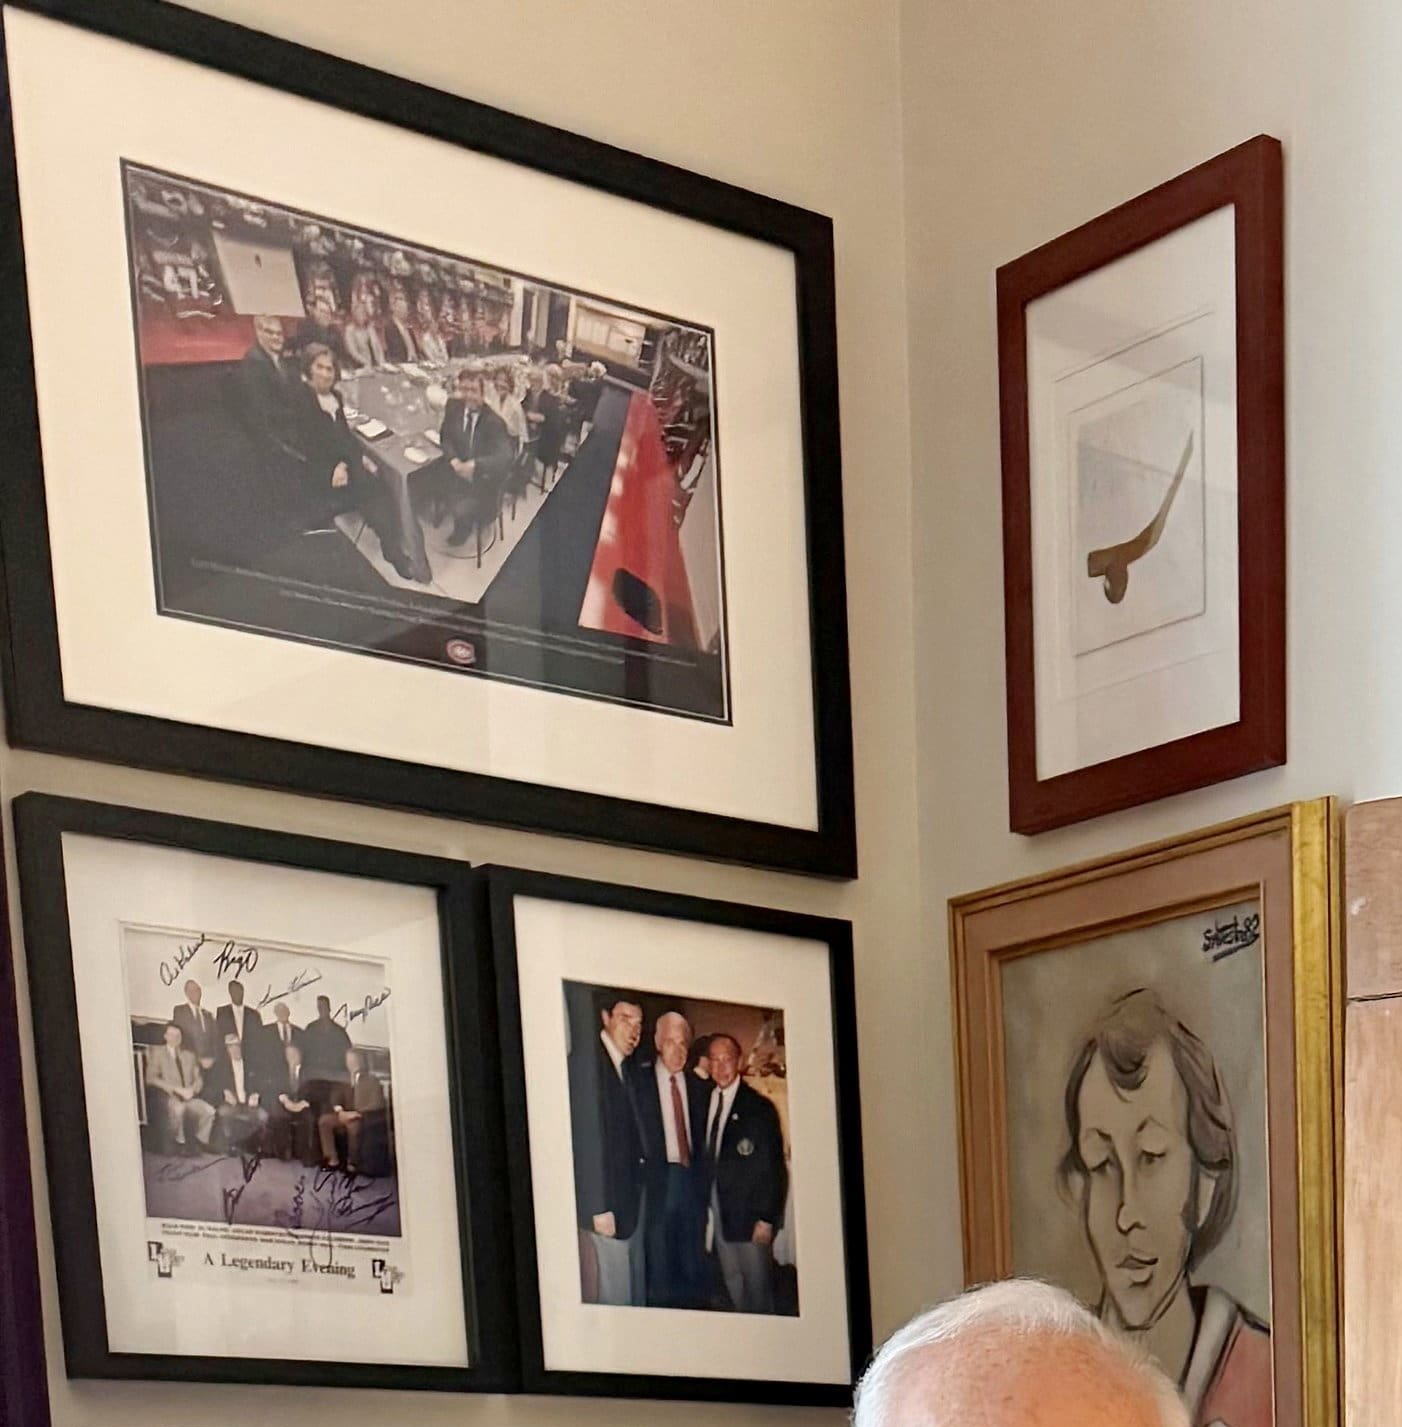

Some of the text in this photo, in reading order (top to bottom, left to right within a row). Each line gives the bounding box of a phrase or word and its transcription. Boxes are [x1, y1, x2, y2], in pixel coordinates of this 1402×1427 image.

[204, 1252, 214, 1266] A
[220, 1252, 295, 1274] Legendary
[301, 1258, 356, 1279] Evening
